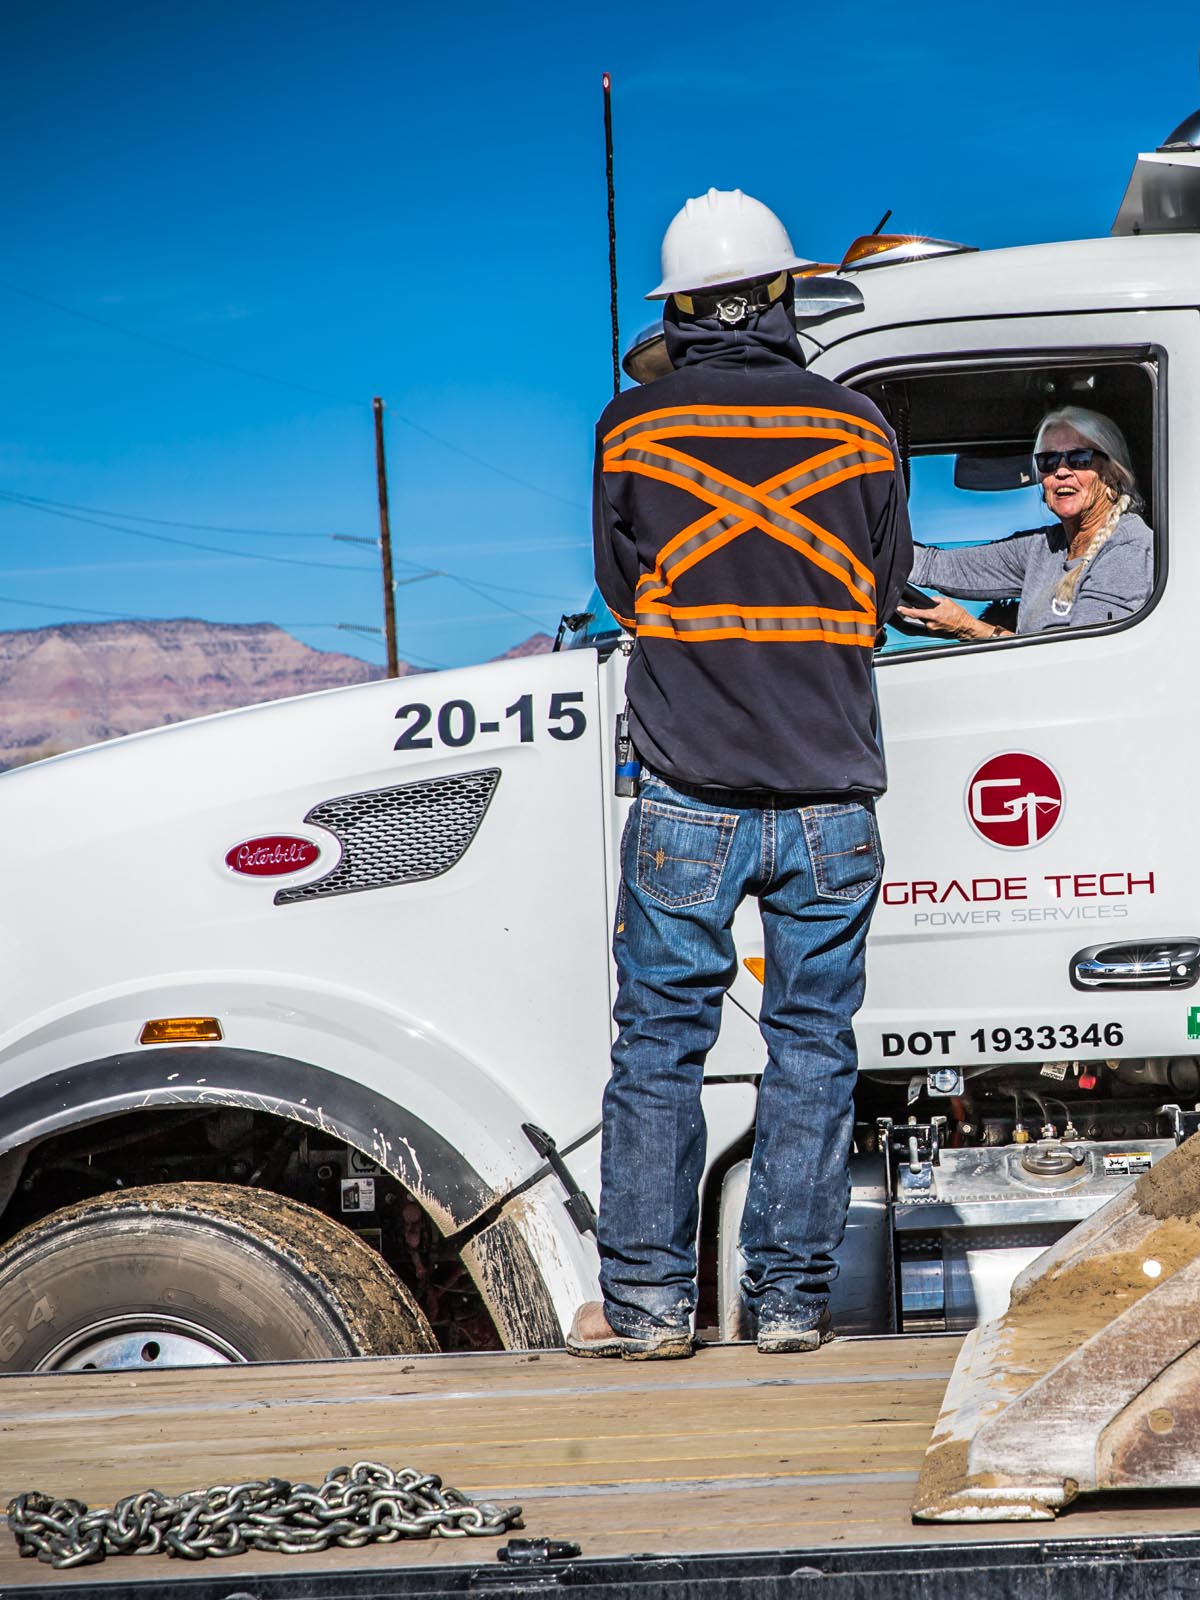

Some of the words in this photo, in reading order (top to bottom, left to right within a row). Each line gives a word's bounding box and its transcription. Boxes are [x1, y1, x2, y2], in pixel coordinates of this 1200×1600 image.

[393, 691, 588, 752] 20-15
[236, 842, 313, 869] Peterbilt
[882, 876, 1028, 906] GRADE
[1044, 871, 1156, 899] TECH
[914, 909, 1001, 927] POWER
[1011, 903, 1129, 922] SERVICES
[882, 1030, 957, 1057] DOT
[970, 1022, 1124, 1053] 1933346
